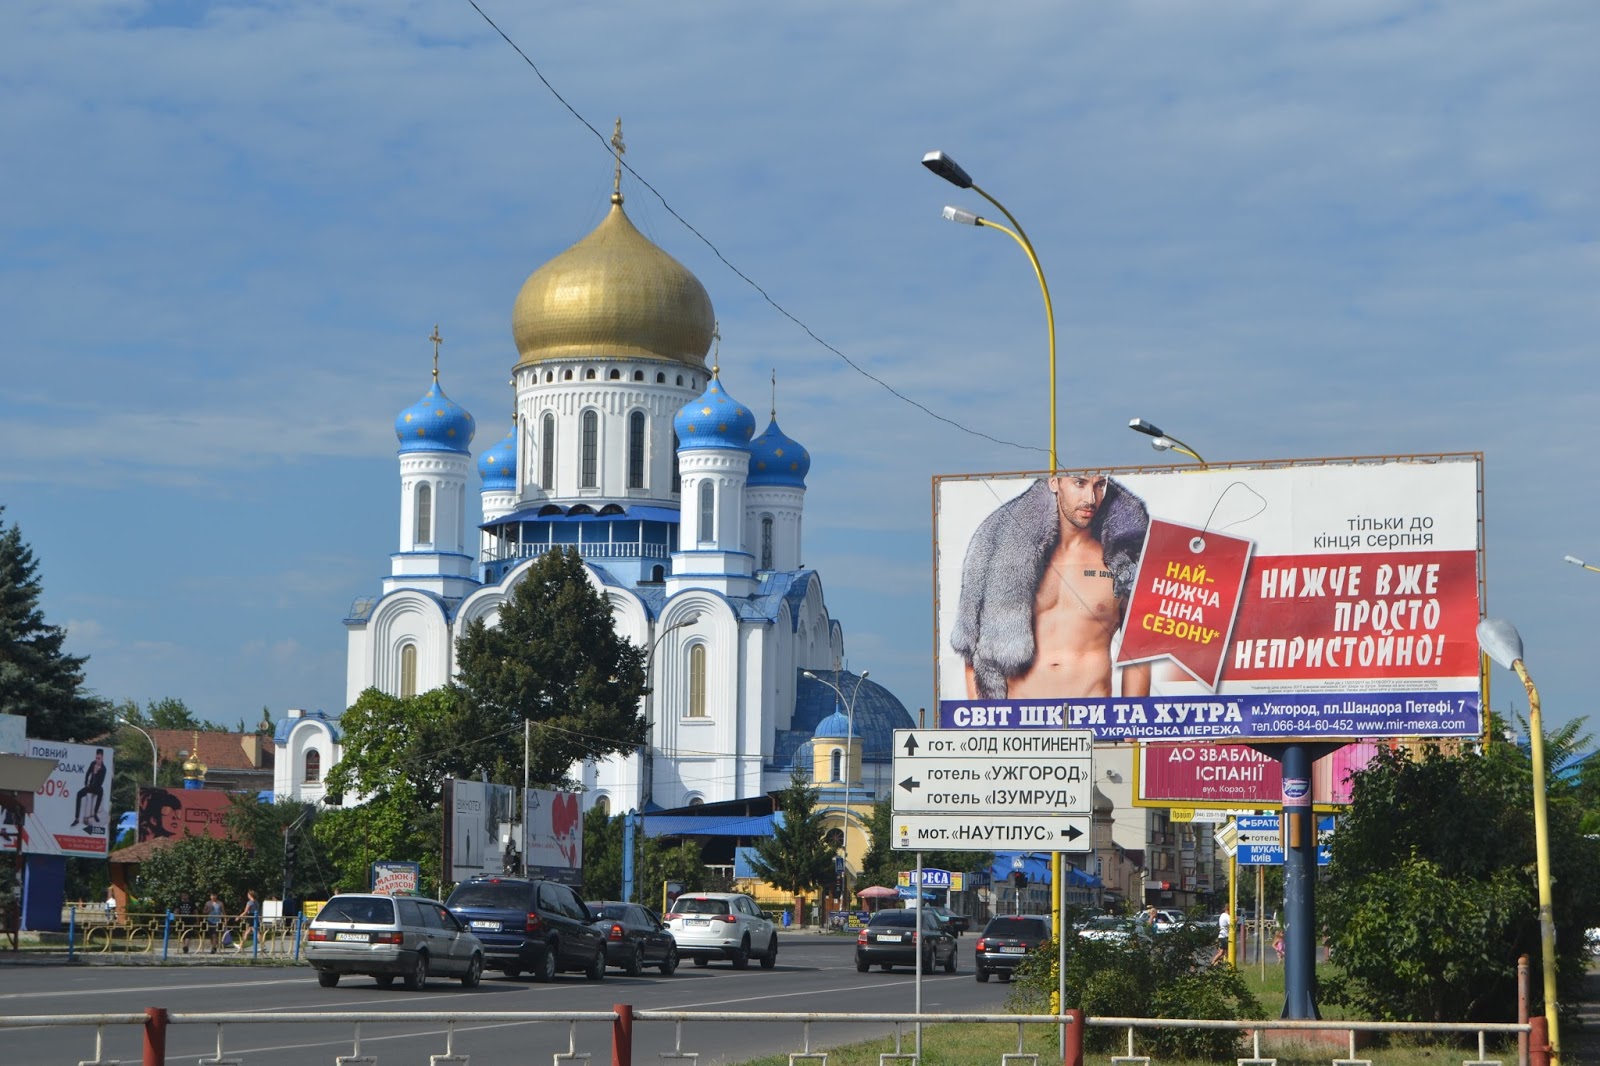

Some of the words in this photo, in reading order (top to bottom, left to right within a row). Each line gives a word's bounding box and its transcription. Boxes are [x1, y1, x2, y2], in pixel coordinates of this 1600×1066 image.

[1347, 515, 1404, 531] тільки
[1409, 516, 1434, 532] до
[1313, 532, 1361, 550] кінця
[1366, 533, 1434, 550] серпня
[1083, 569, 1096, 578] ONE
[1260, 565, 1362, 599] НИЖЧЕ
[1375, 563, 1440, 596] ВЖЕ
[1151, 577, 1220, 609] НИЖЧА
[1159, 599, 1204, 624] ЦІНА
[1333, 598, 1441, 632] ПРОСТО
[1234, 629, 1445, 669] НЕПРИСТОЙНО!
[953, 706, 1012, 727] СВІТ
[1019, 704, 1106, 726] ШКІРИ
[1112, 703, 1148, 724] ТА
[1251, 702, 1320, 717] м.Ужгород,
[1323, 701, 1402, 715] пл.Шандора
[1405, 700, 1454, 716] Петефі,
[1458, 700, 1465, 712] 7
[1101, 725, 1181, 737] УКРАЇНСЬКА
[1182, 724, 1241, 736] МЕРЕЖА
[1251, 719, 1354, 732] тел.066-84-60-452
[1356, 718, 1466, 731] www.mir-mexa.com
[32, 746, 68, 759] ПОВНИЙ
[928, 739, 956, 752] гот.
[959, 736, 998, 754] «ОЛД
[1003, 736, 1091, 752] КОНТИНЕНТ»
[1168, 748, 1196, 763] ДО
[1199, 748, 1280, 763] ЗВАБЛИВ
[927, 768, 980, 780] готель
[984, 765, 1088, 783] «УЖГОРОД»
[1196, 764, 1265, 782] ІСПАНІЇ
[1247, 785, 1257, 793] 17
[927, 792, 980, 804] готель
[984, 789, 1077, 807] «ІЗУМРУД»
[918, 828, 949, 840] мот.
[951, 825, 1054, 841] «НАУТІЛУС»
[1250, 853, 1272, 863] КИЇВ
[911, 872, 949, 884] ПРЕСА
